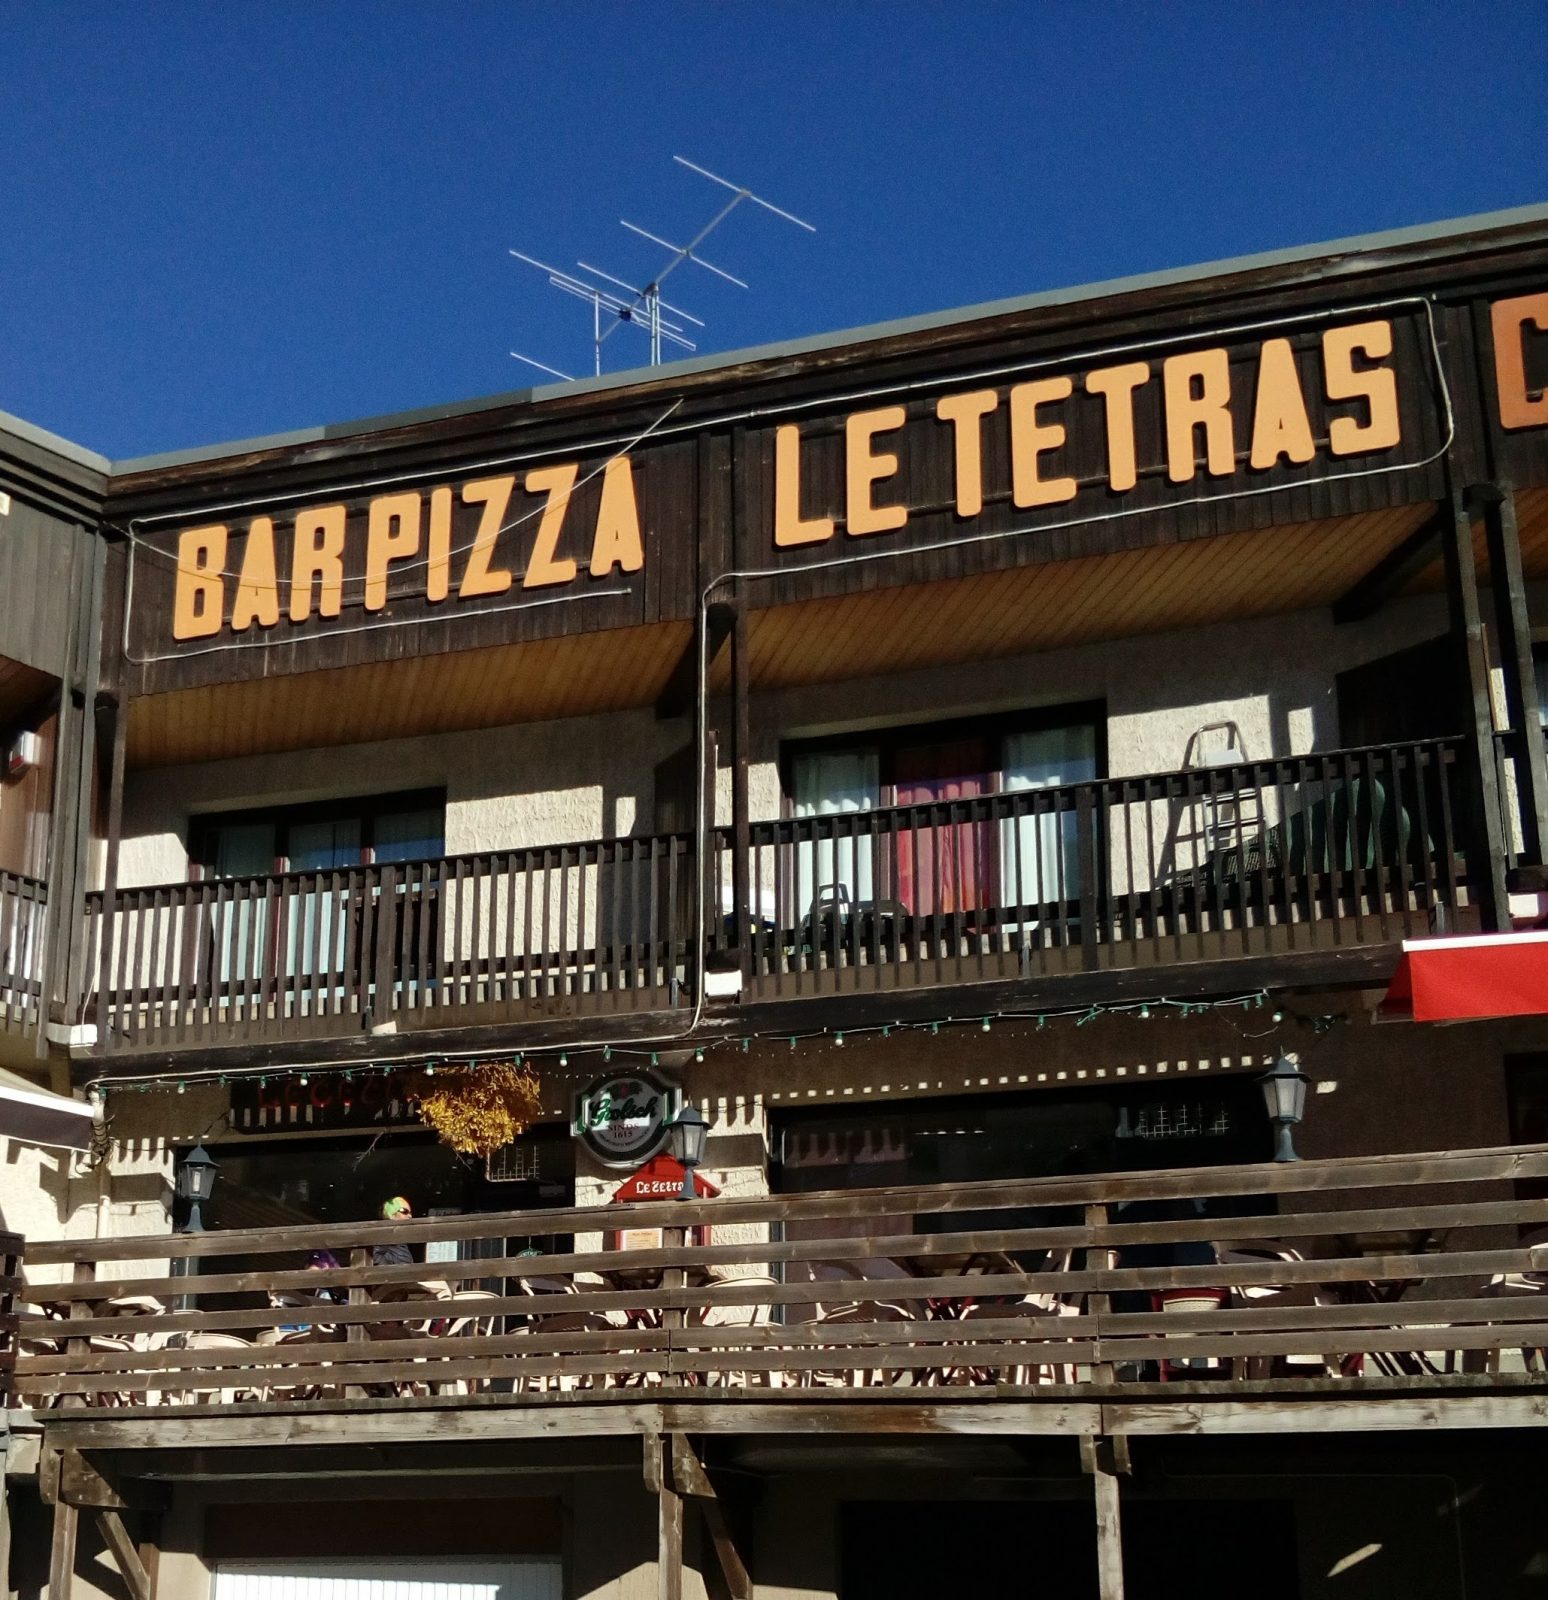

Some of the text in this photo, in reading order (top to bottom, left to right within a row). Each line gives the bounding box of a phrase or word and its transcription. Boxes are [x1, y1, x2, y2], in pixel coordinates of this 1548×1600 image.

[775, 320, 1400, 547] LE TETRAS
[173, 455, 645, 640] BAR PIZZA
[589, 1097, 658, 1127] Grolsch
